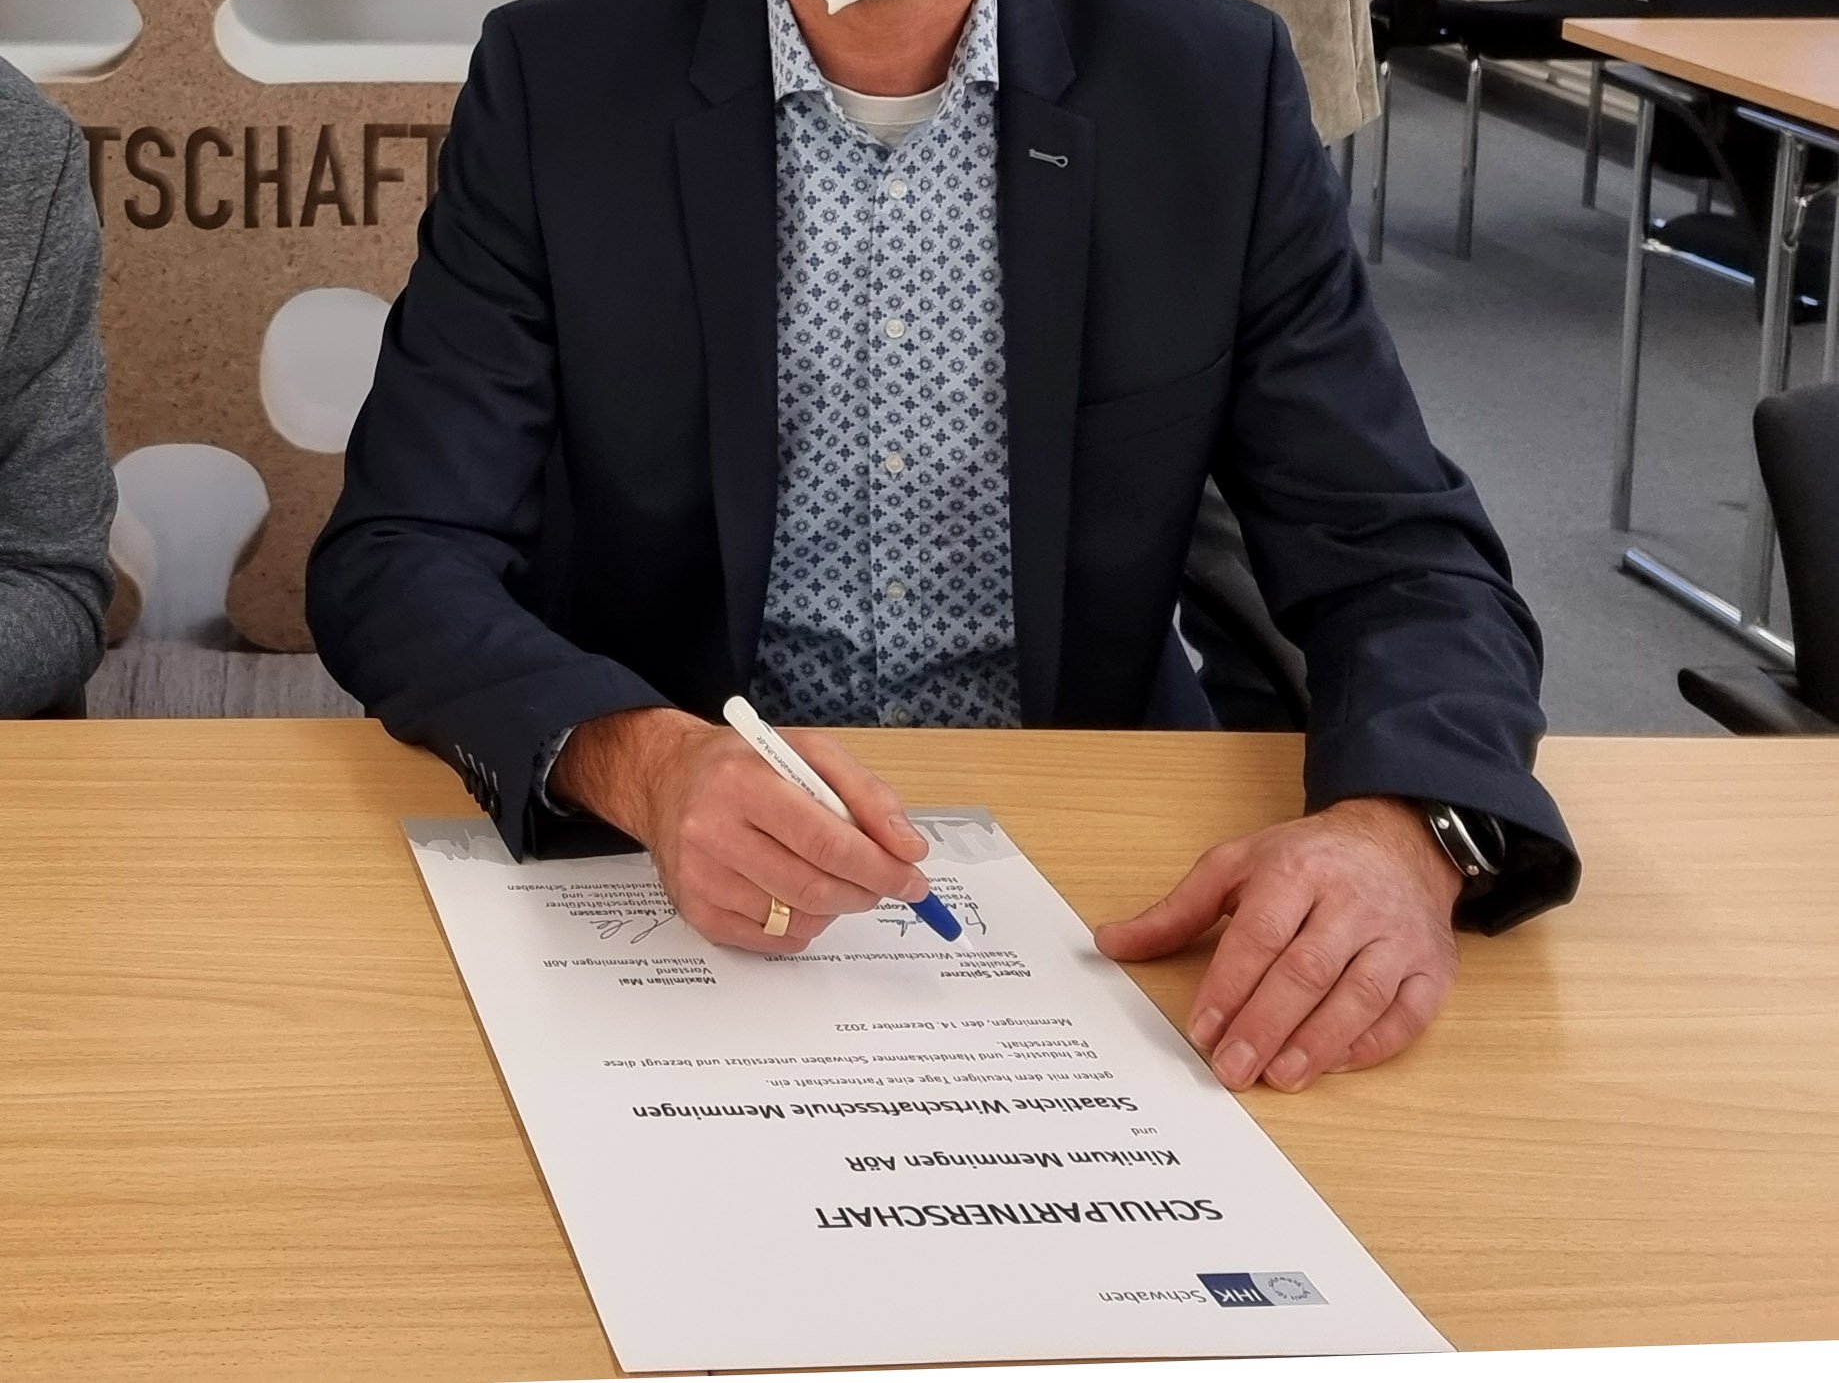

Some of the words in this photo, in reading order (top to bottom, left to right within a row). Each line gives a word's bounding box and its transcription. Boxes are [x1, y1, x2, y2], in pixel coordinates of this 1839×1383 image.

[81, 123, 452, 230] TSCHAFT
[507, 883, 566, 893] Schwaben
[570, 882, 663, 891] Handelskammer
[946, 885, 964, 893] der
[561, 893, 584, 901] und
[587, 891, 644, 899] Industrie-
[545, 899, 672, 909] Hauptgeschäftsführer
[958, 901, 979, 909] Dr.
[570, 909, 623, 917] Lucassen
[624, 908, 657, 917] Marc
[658, 907, 677, 916] Dr.
[763, 953, 842, 965] Memmingen
[843, 951, 954, 963] Wirtschaftsschule
[954, 950, 1018, 959] Staatliche
[542, 959, 568, 969] AöR
[571, 957, 648, 967] Memmingen
[650, 957, 706, 967] Klinikum
[959, 959, 1026, 969] Schulleiter
[656, 967, 712, 975] Vorstand
[939, 969, 992, 979] Spitzner
[993, 969, 1032, 979] Albert
[936, 1021, 958, 1029] 14.
[960, 1020, 984, 1029] den
[986, 1016, 1073, 1027] Memmingen,
[834, 1023, 868, 1033] 2022
[872, 1021, 934, 1033] Dezember
[996, 1039, 1090, 1049] Partnerschaft.
[872, 1052, 975, 1064] Handelskammer
[978, 1051, 1003, 1061] und
[1006, 1050, 1072, 1061] Industrie-
[1074, 1050, 1098, 1059] Die
[602, 1059, 636, 1069] diese
[638, 1057, 693, 1069] bezeugt
[695, 1059, 720, 1069] und
[724, 1057, 798, 1068] unterstützt
[800, 1055, 869, 1066] Schwaben
[888, 1077, 915, 1085] eine
[918, 1073, 950, 1085] Tage
[953, 1073, 1012, 1084] heutigen
[1014, 1073, 1042, 1083] dem
[1046, 1073, 1070, 1083] mit
[1072, 1070, 1114, 1082] gehen
[766, 1079, 790, 1089] ein.
[794, 1077, 884, 1087] Partnerschaft
[790, 1099, 1010, 1118] Wirtschaftsschule
[1011, 1096, 1138, 1113] Staatliche
[632, 1103, 786, 1121] Memmingen
[1130, 1127, 1158, 1137] und
[904, 1151, 1064, 1170] Memmingen
[1067, 1149, 1181, 1167] Klinikum
[844, 1155, 897, 1172] AöR
[814, 1199, 1224, 1229] SCHULPARTNERSCHAFT
[1098, 1289, 1207, 1304] Schwaben
[1213, 1288, 1263, 1303] IHK
